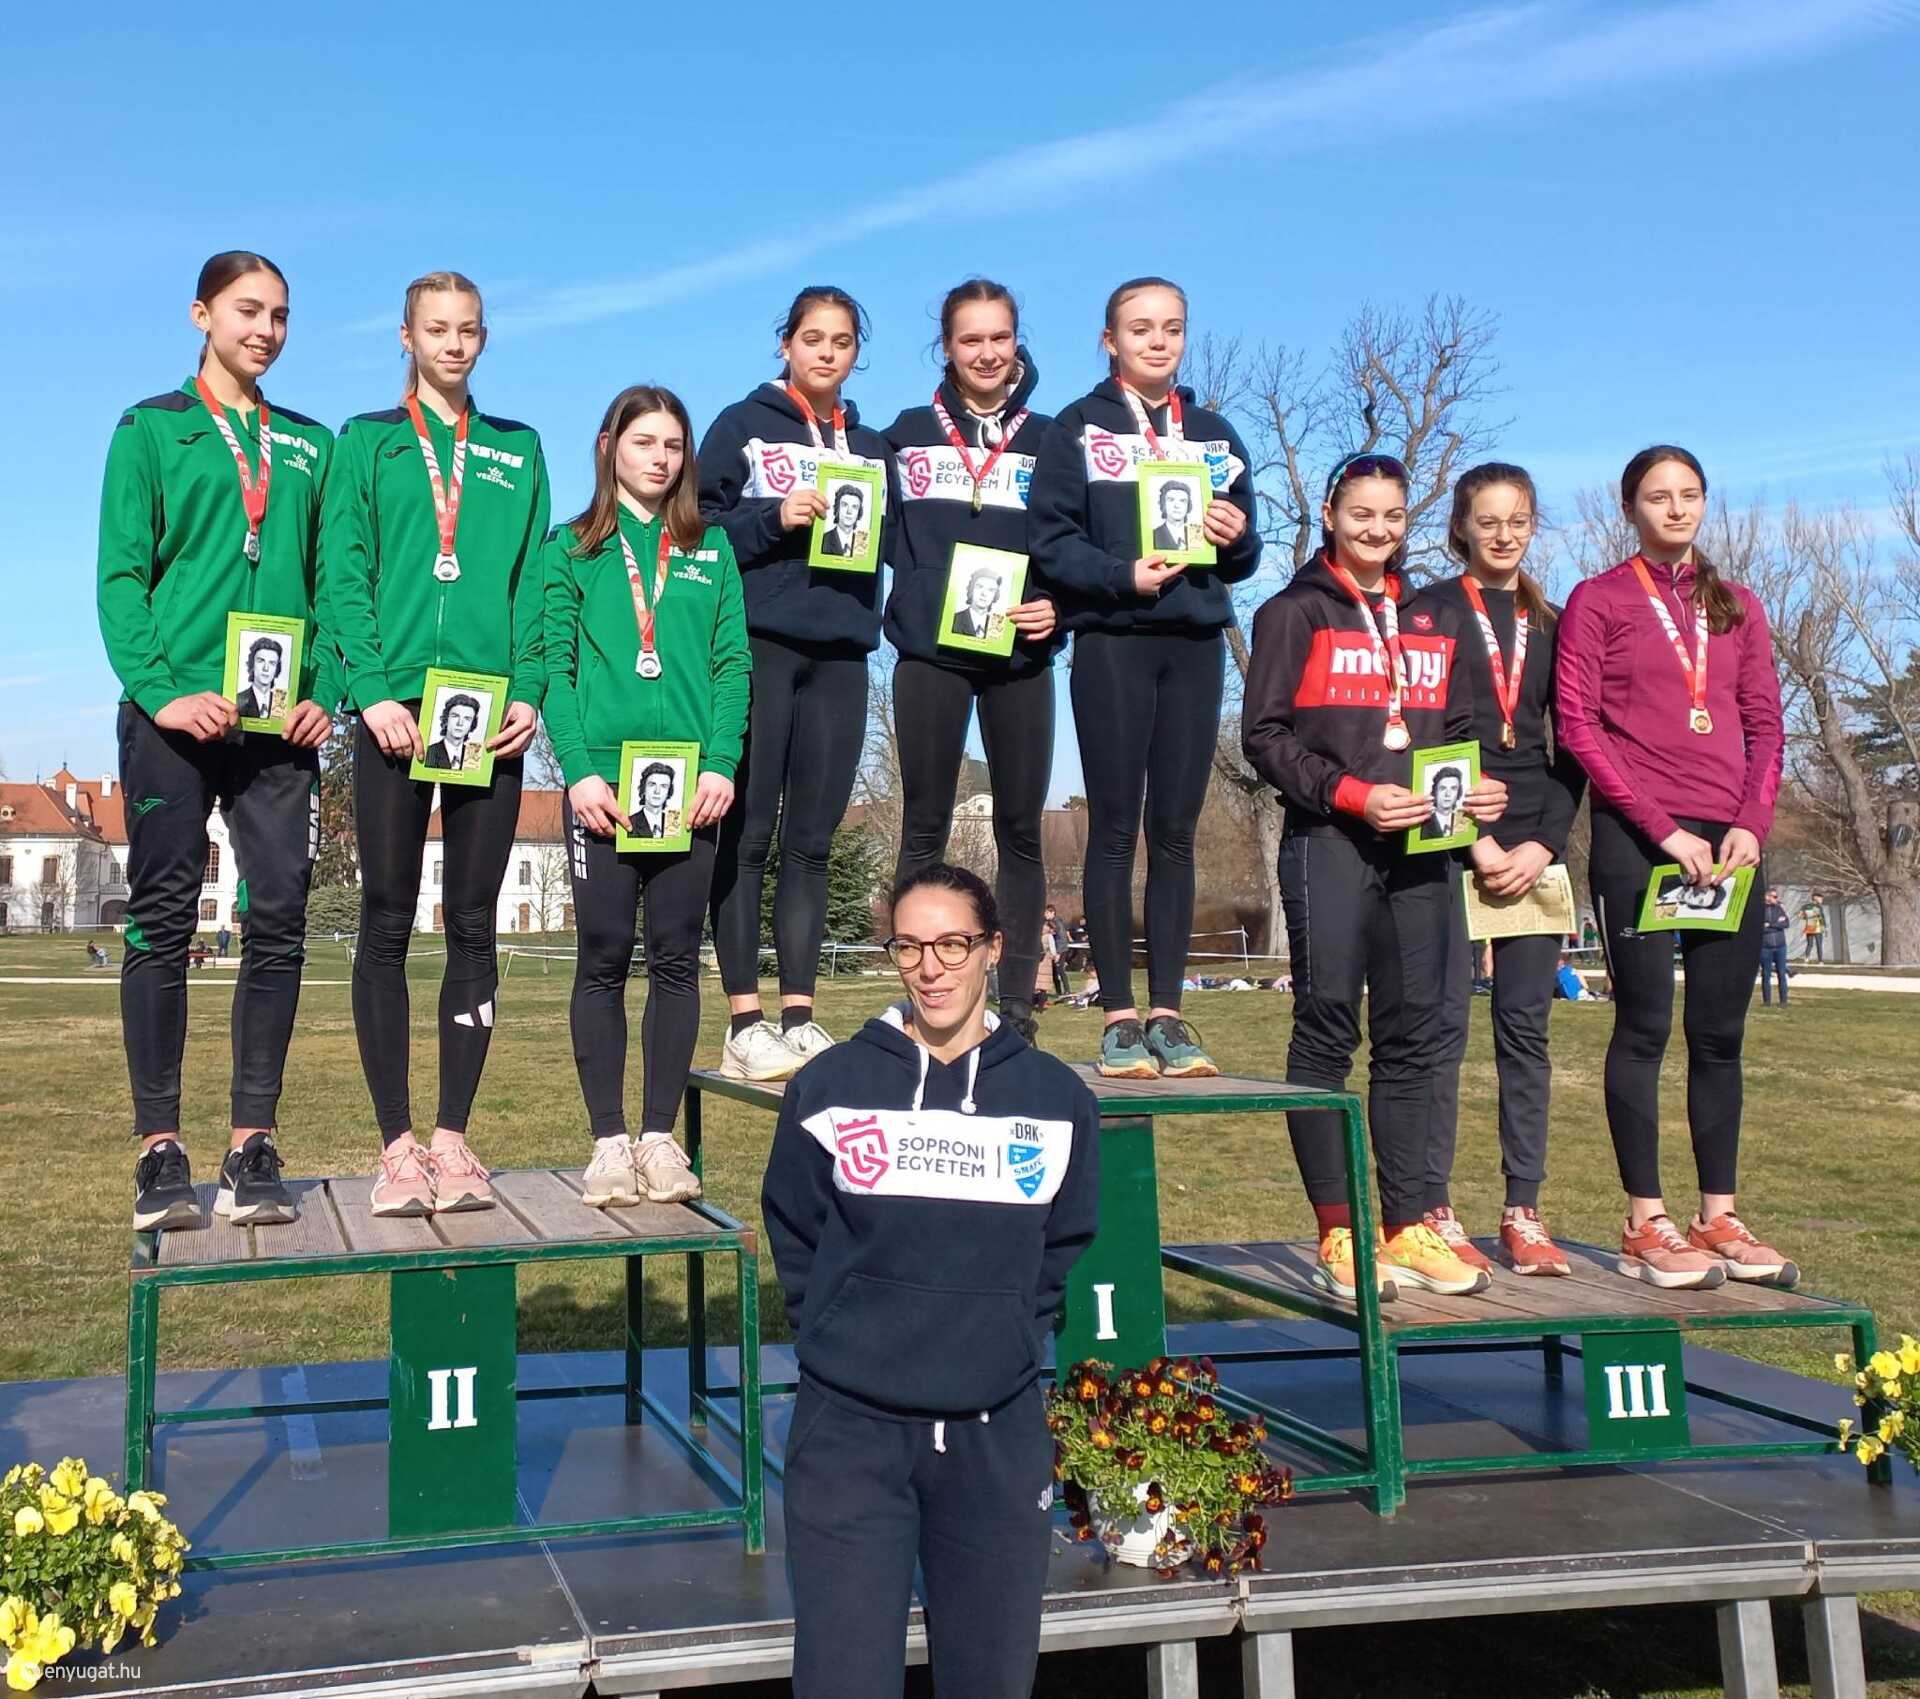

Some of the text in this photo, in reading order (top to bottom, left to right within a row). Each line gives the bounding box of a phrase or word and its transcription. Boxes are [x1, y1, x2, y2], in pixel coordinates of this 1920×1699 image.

[936, 461, 1000, 477] SOPONI
[936, 472, 999, 489] EGYEEM
[898, 1136, 985, 1160] SOPRONI
[896, 1154, 986, 1179] EGYETEM
[1093, 1283, 1118, 1340] I
[427, 1366, 478, 1430] II
[1604, 1364, 1671, 1419] III
